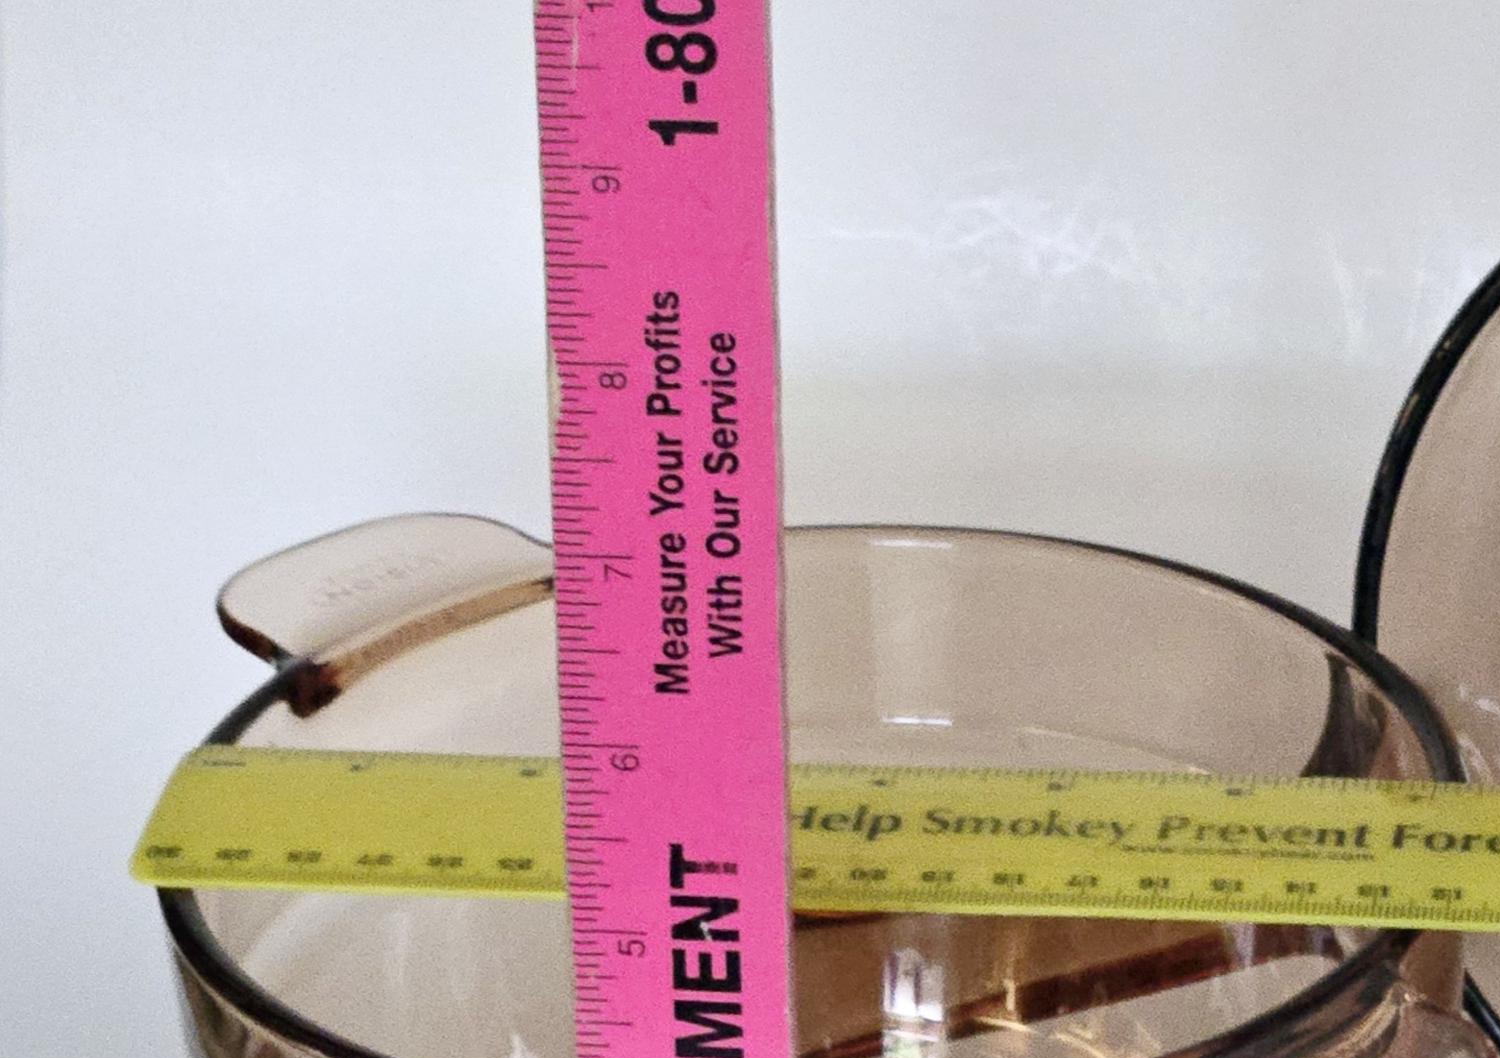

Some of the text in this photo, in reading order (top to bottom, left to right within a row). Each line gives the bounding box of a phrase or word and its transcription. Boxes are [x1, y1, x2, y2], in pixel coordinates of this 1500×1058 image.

[592, 174, 621, 194] 9
[599, 371, 628, 391] 8
[645, 291, 690, 695] Measure Your Profits
[702, 332, 744, 658] With Our Service
[603, 563, 634, 582] 7
[611, 754, 640, 773] 6
[922, 806, 1136, 846] Smokey
[1157, 814, 1369, 849] Prevent
[617, 939, 646, 958] 5
